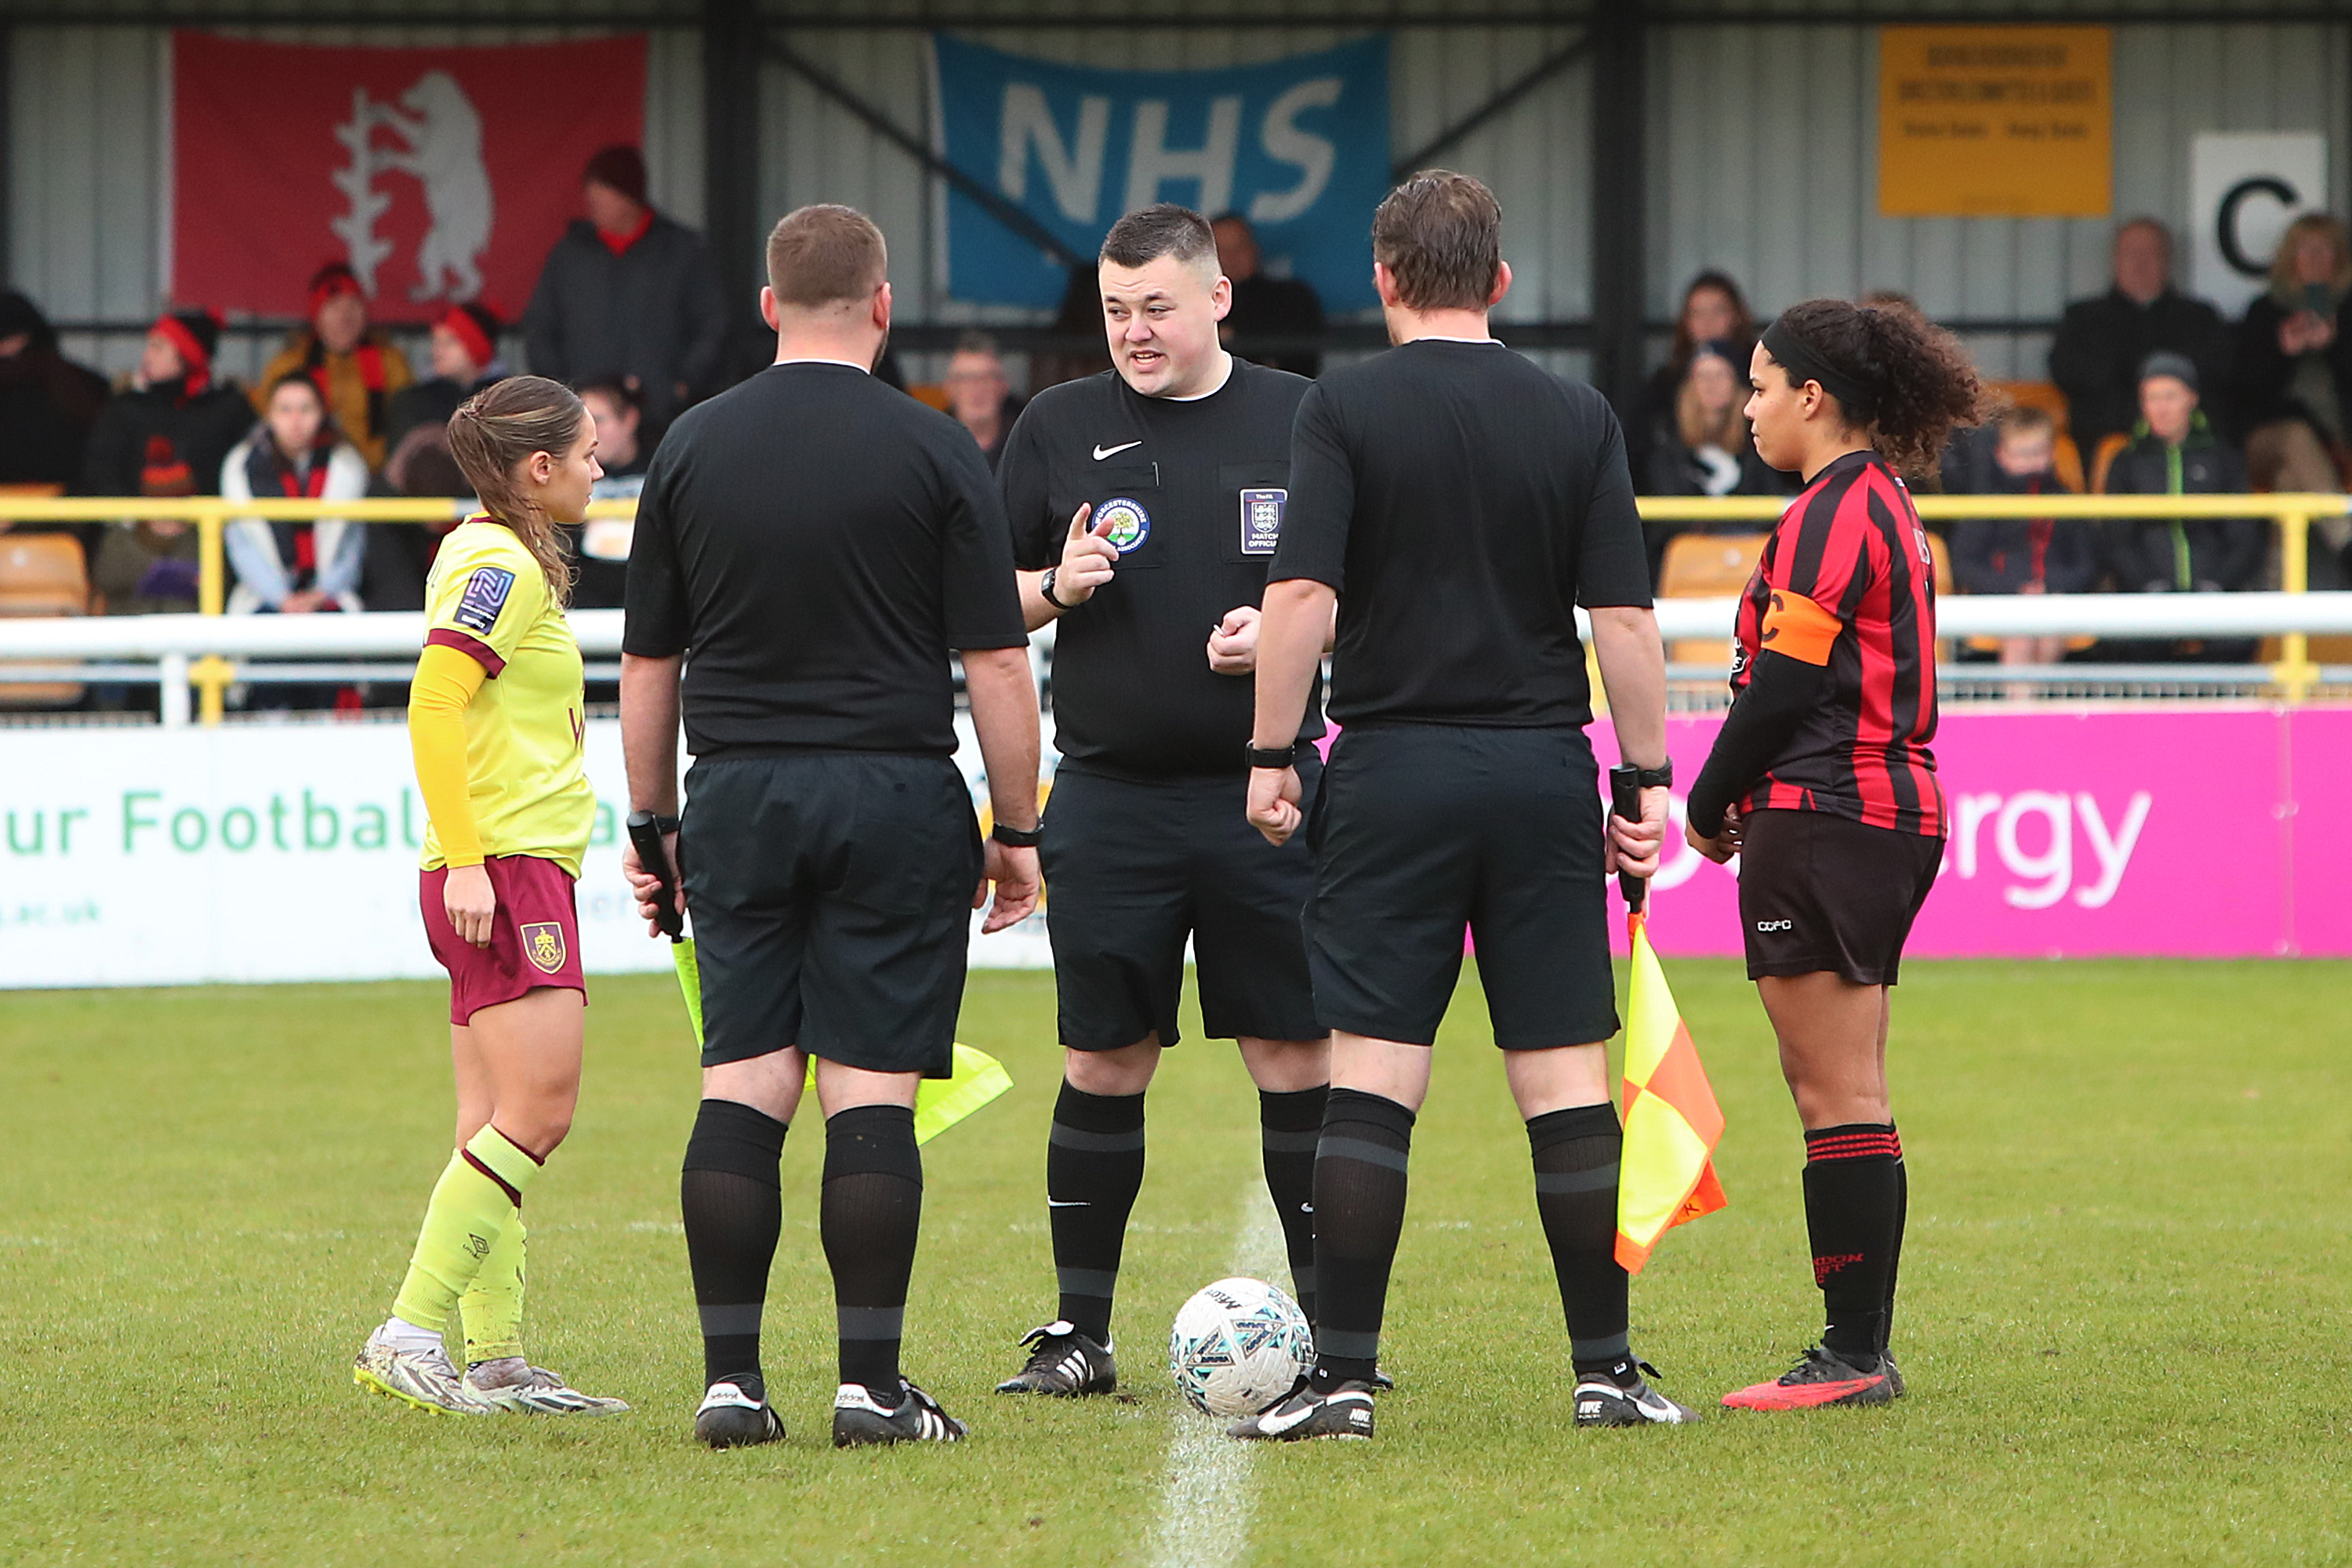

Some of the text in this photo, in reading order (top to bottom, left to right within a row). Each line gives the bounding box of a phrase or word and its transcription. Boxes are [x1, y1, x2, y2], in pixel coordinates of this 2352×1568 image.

[997, 76, 1344, 226] NHS
[2216, 175, 2299, 278] C
[122, 789, 423, 855] Footbal
[1944, 790, 2153, 909] rgy
